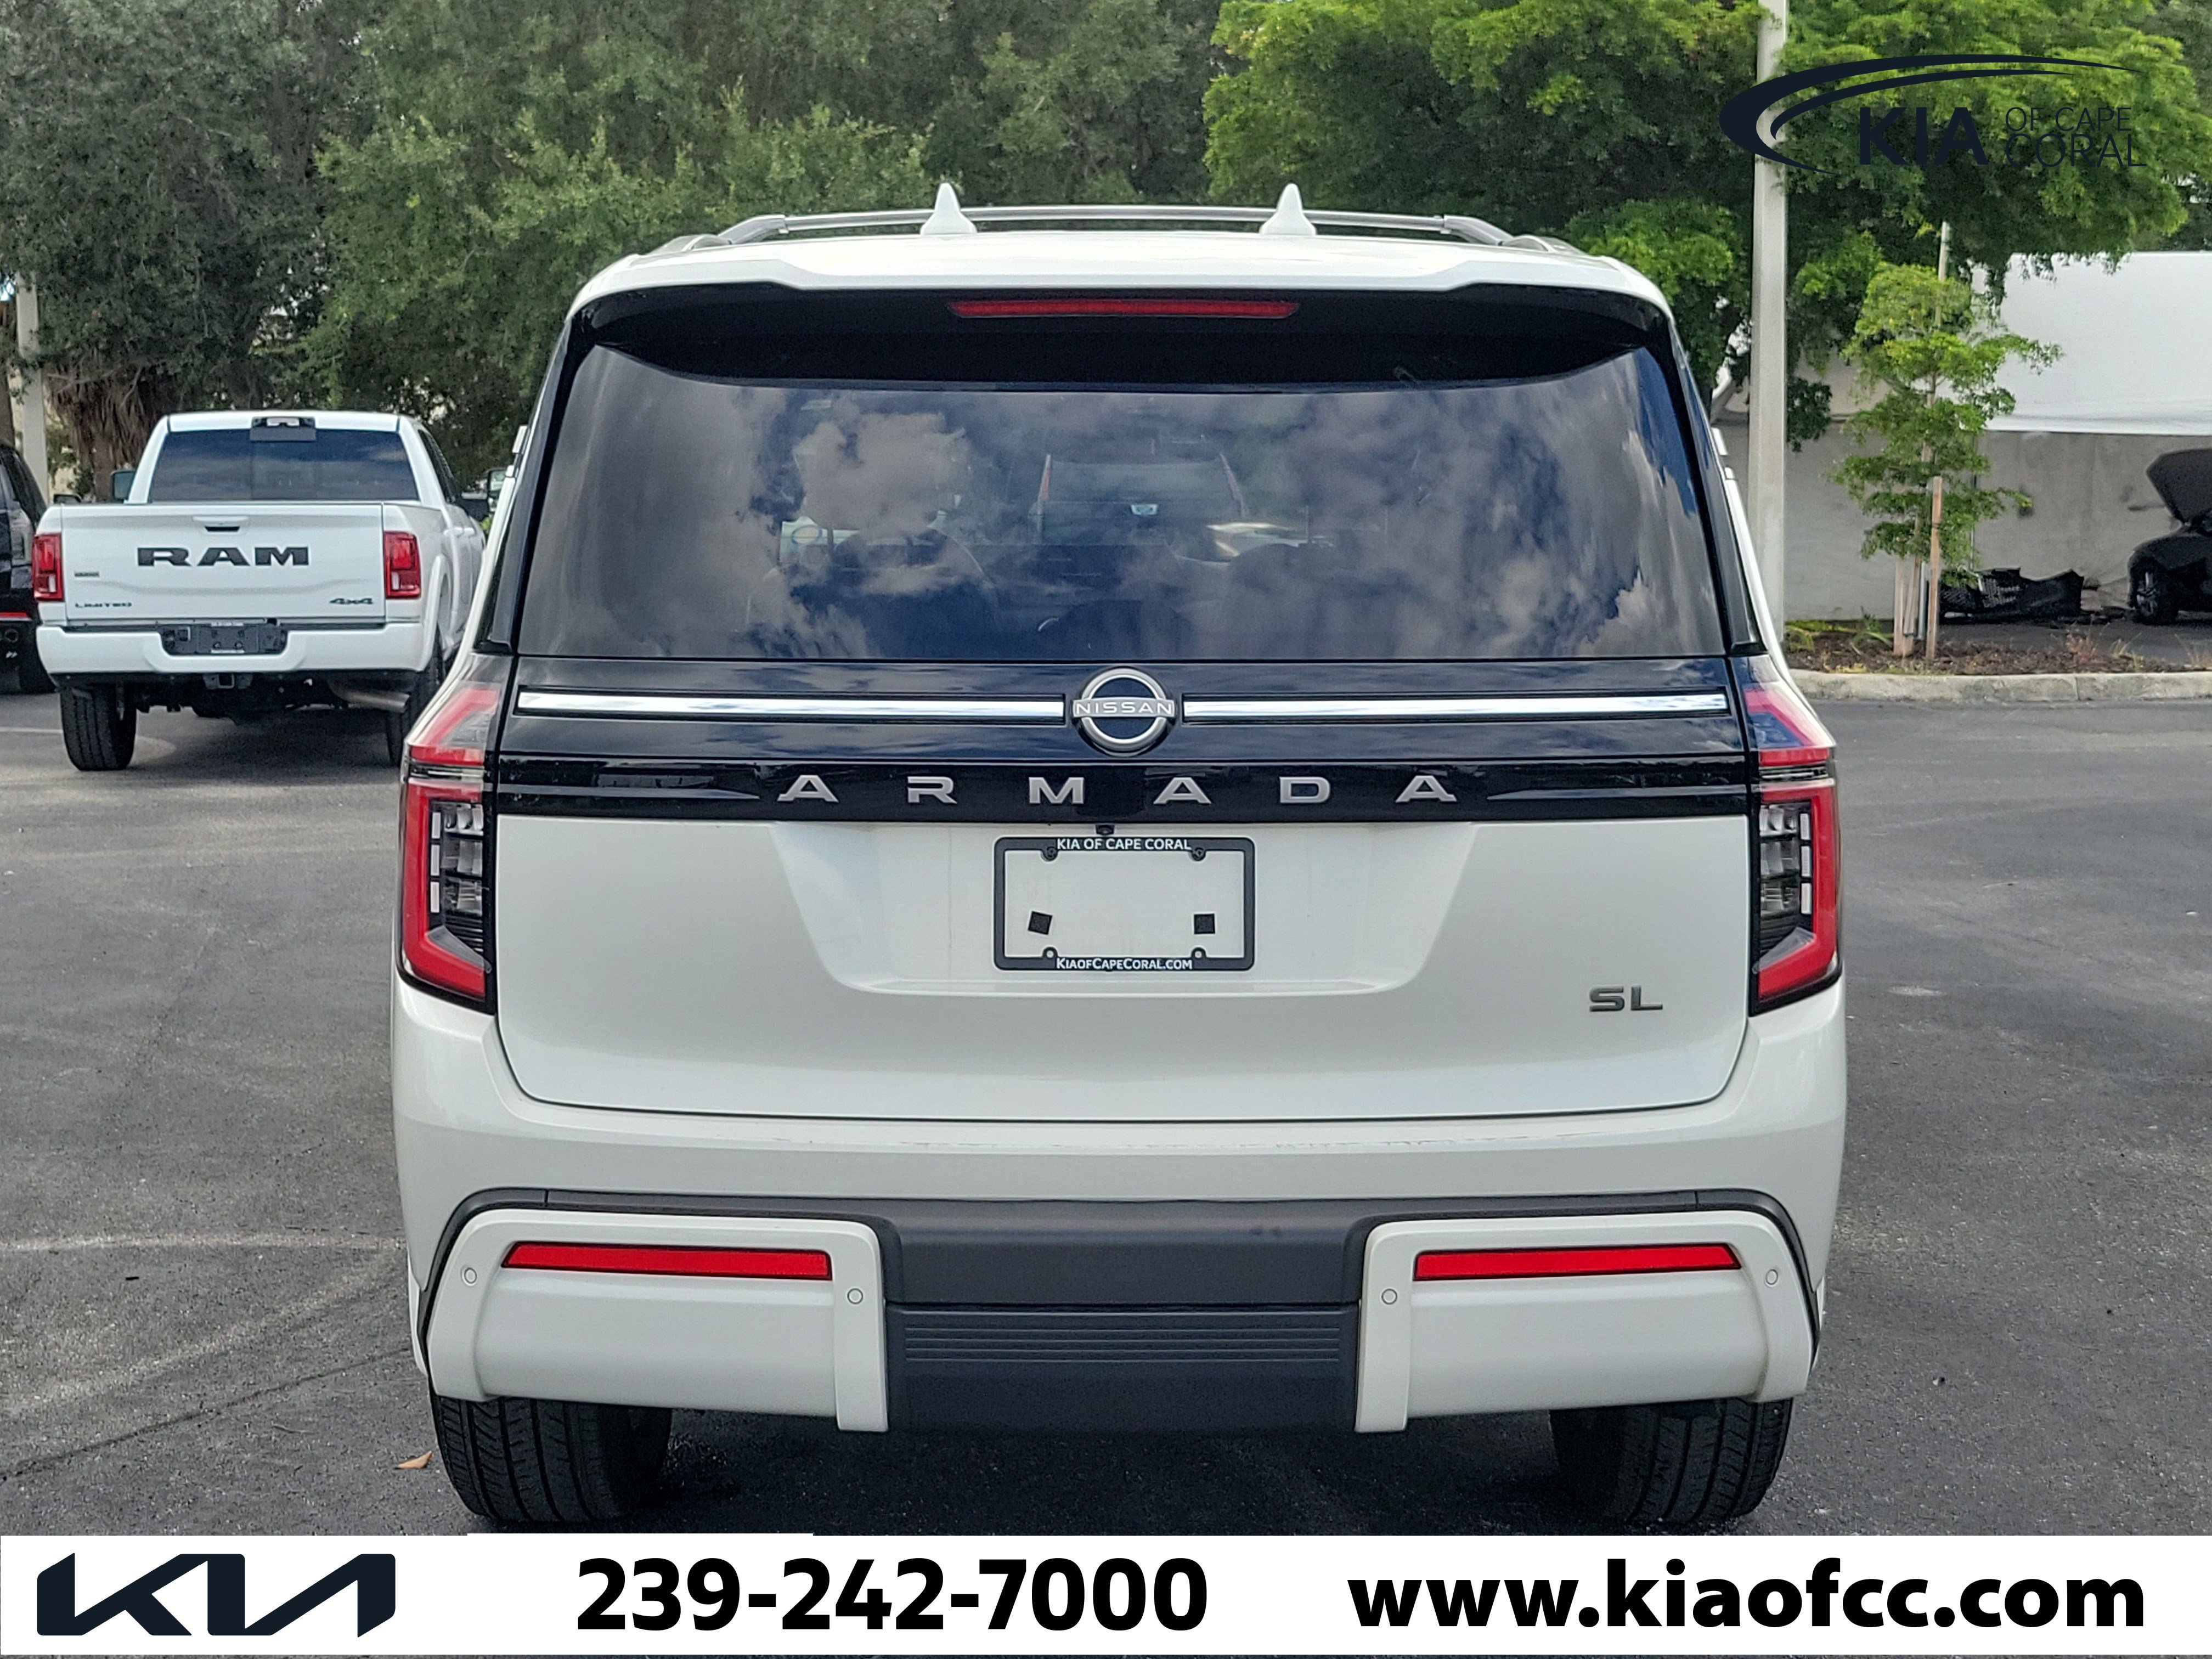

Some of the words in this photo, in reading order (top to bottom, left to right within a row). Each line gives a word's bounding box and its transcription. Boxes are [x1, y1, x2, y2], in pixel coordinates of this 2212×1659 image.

[137, 547, 309, 566] RAM
[1076, 702, 1172, 714] NISSAN
[777, 774, 1457, 805] ARMADA
[1057, 839, 1080, 850] KIA
[1084, 838, 1102, 850] OF
[1105, 838, 1142, 850] CAPE
[1144, 838, 1191, 850] CORAL
[1589, 986, 1663, 1011] SL
